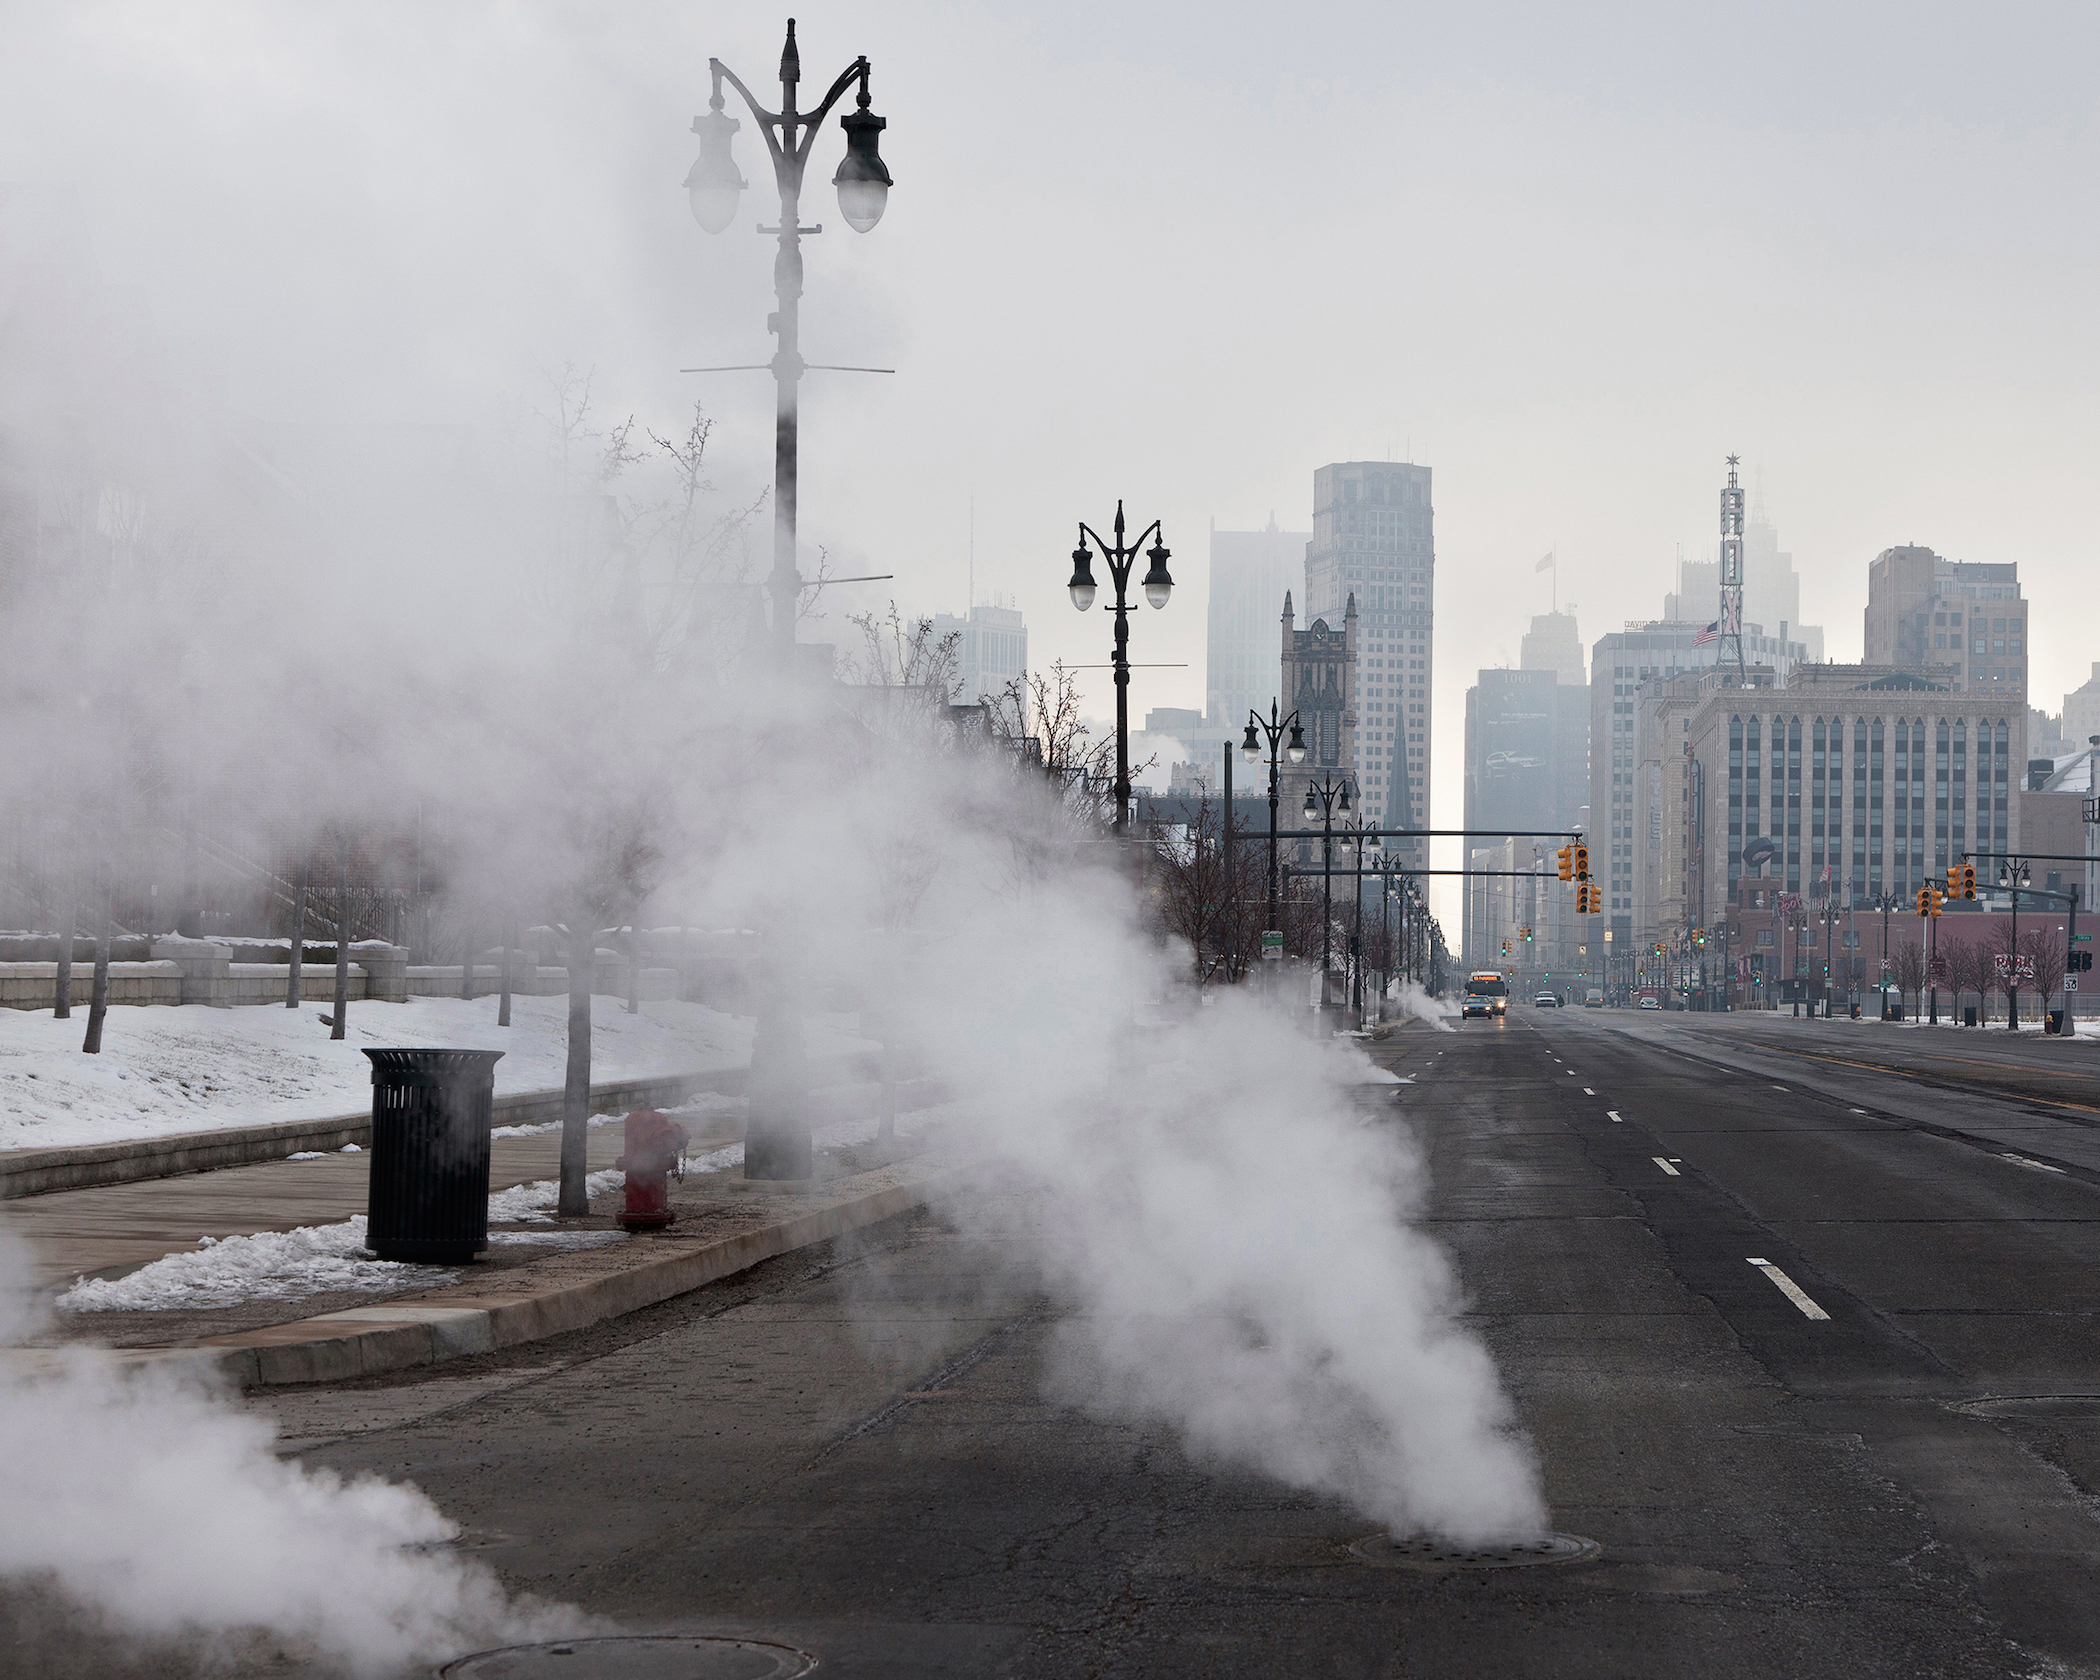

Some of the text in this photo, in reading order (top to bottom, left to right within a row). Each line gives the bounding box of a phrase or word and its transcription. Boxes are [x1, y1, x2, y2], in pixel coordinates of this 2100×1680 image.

[1722, 488, 1743, 635] FOX
[1624, 620, 1648, 628] DAVID
[1504, 673, 1531, 684] 1001
